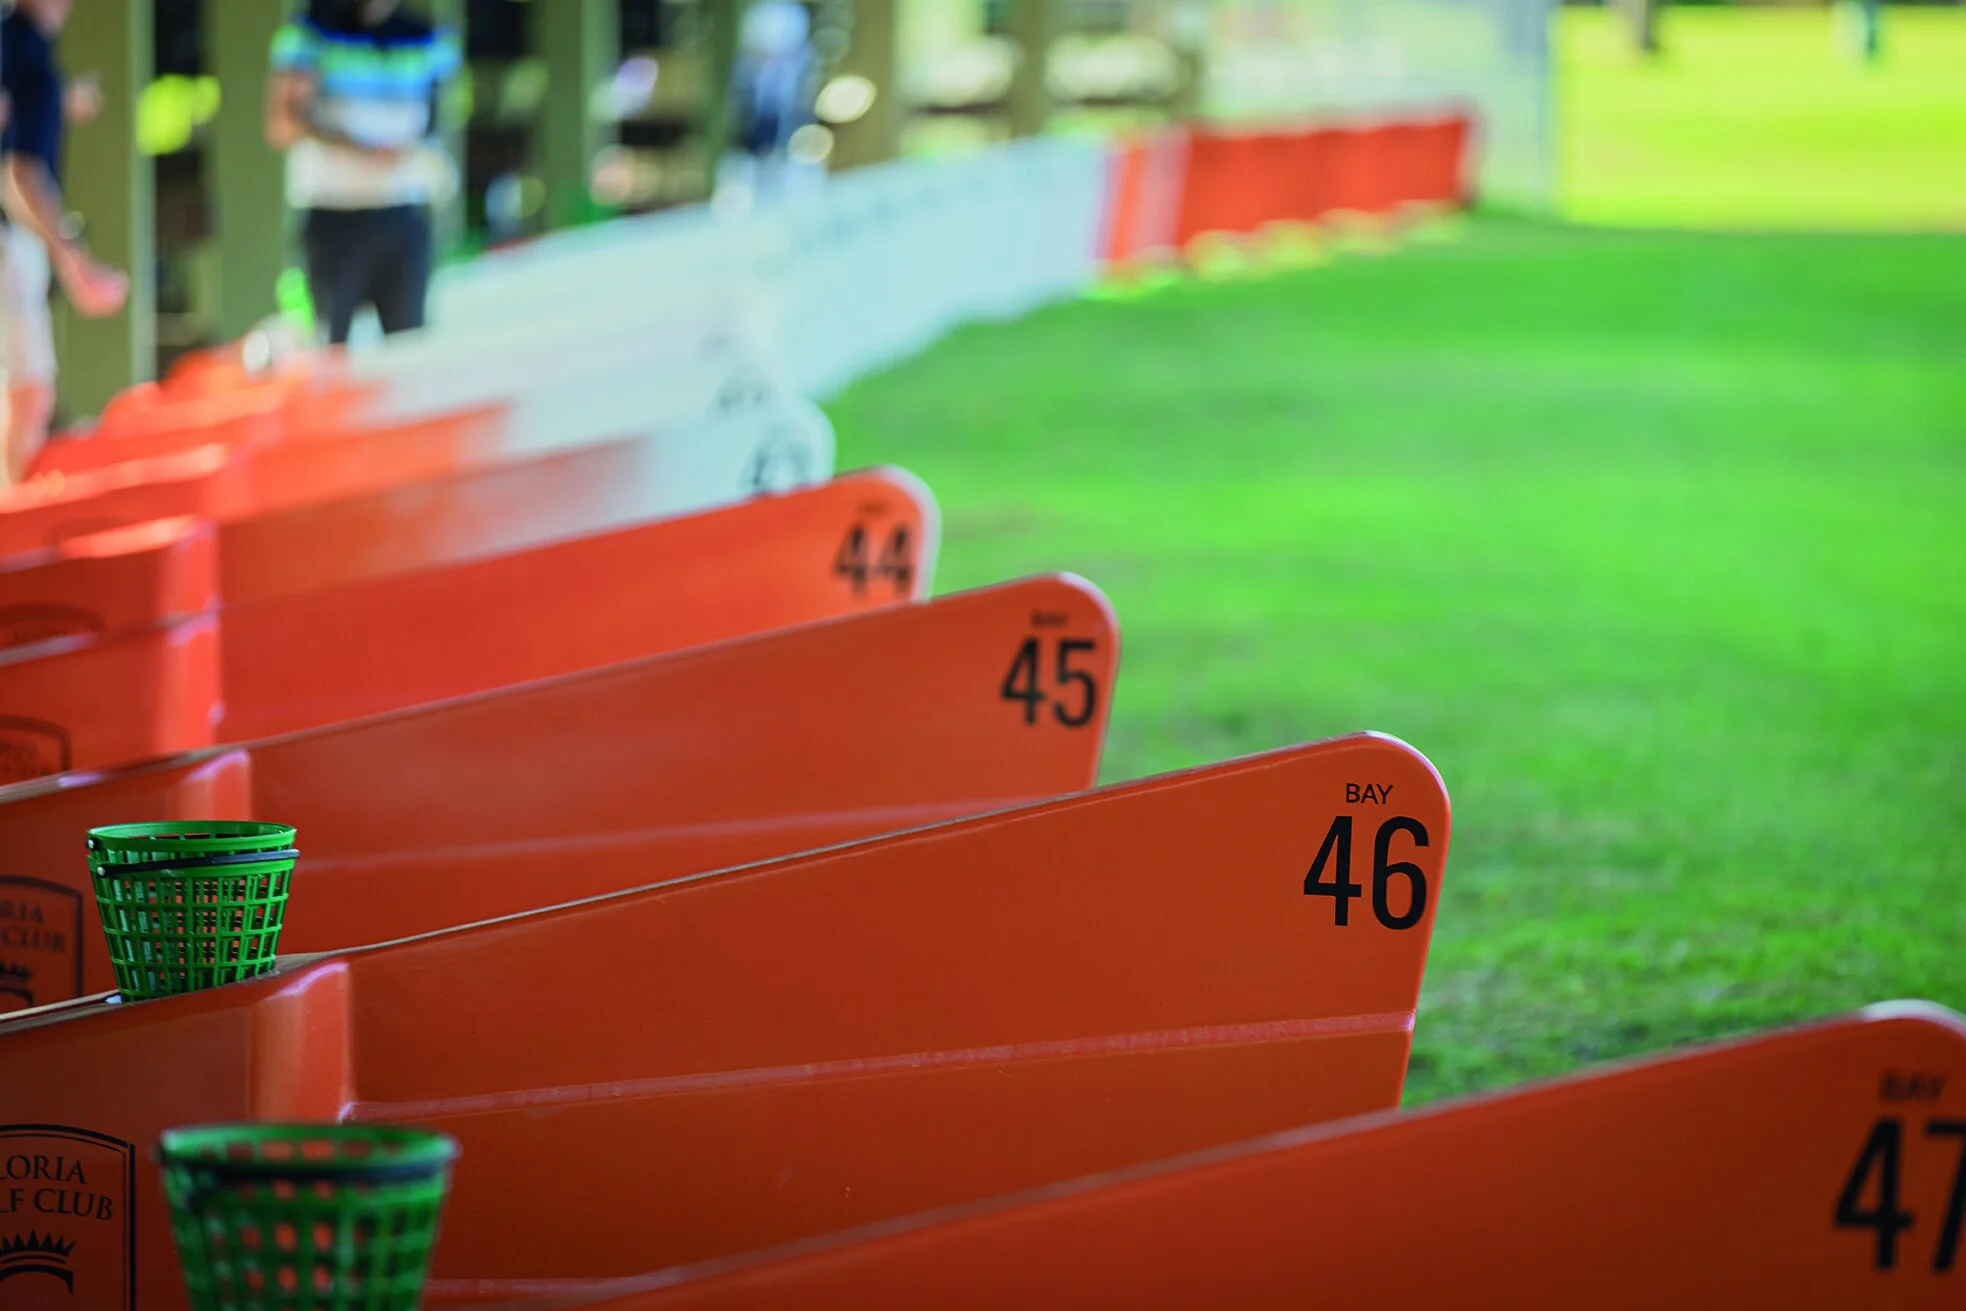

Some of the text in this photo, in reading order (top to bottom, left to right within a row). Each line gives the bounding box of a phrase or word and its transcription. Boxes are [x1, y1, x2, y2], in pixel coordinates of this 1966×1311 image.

[833, 523, 912, 598] 44
[1001, 638, 1096, 727] 45
[1345, 783, 1394, 804] BAY
[1303, 815, 1430, 930] 46
[33, 1188, 112, 1220] CLUB
[1834, 1116, 1966, 1273] 47
